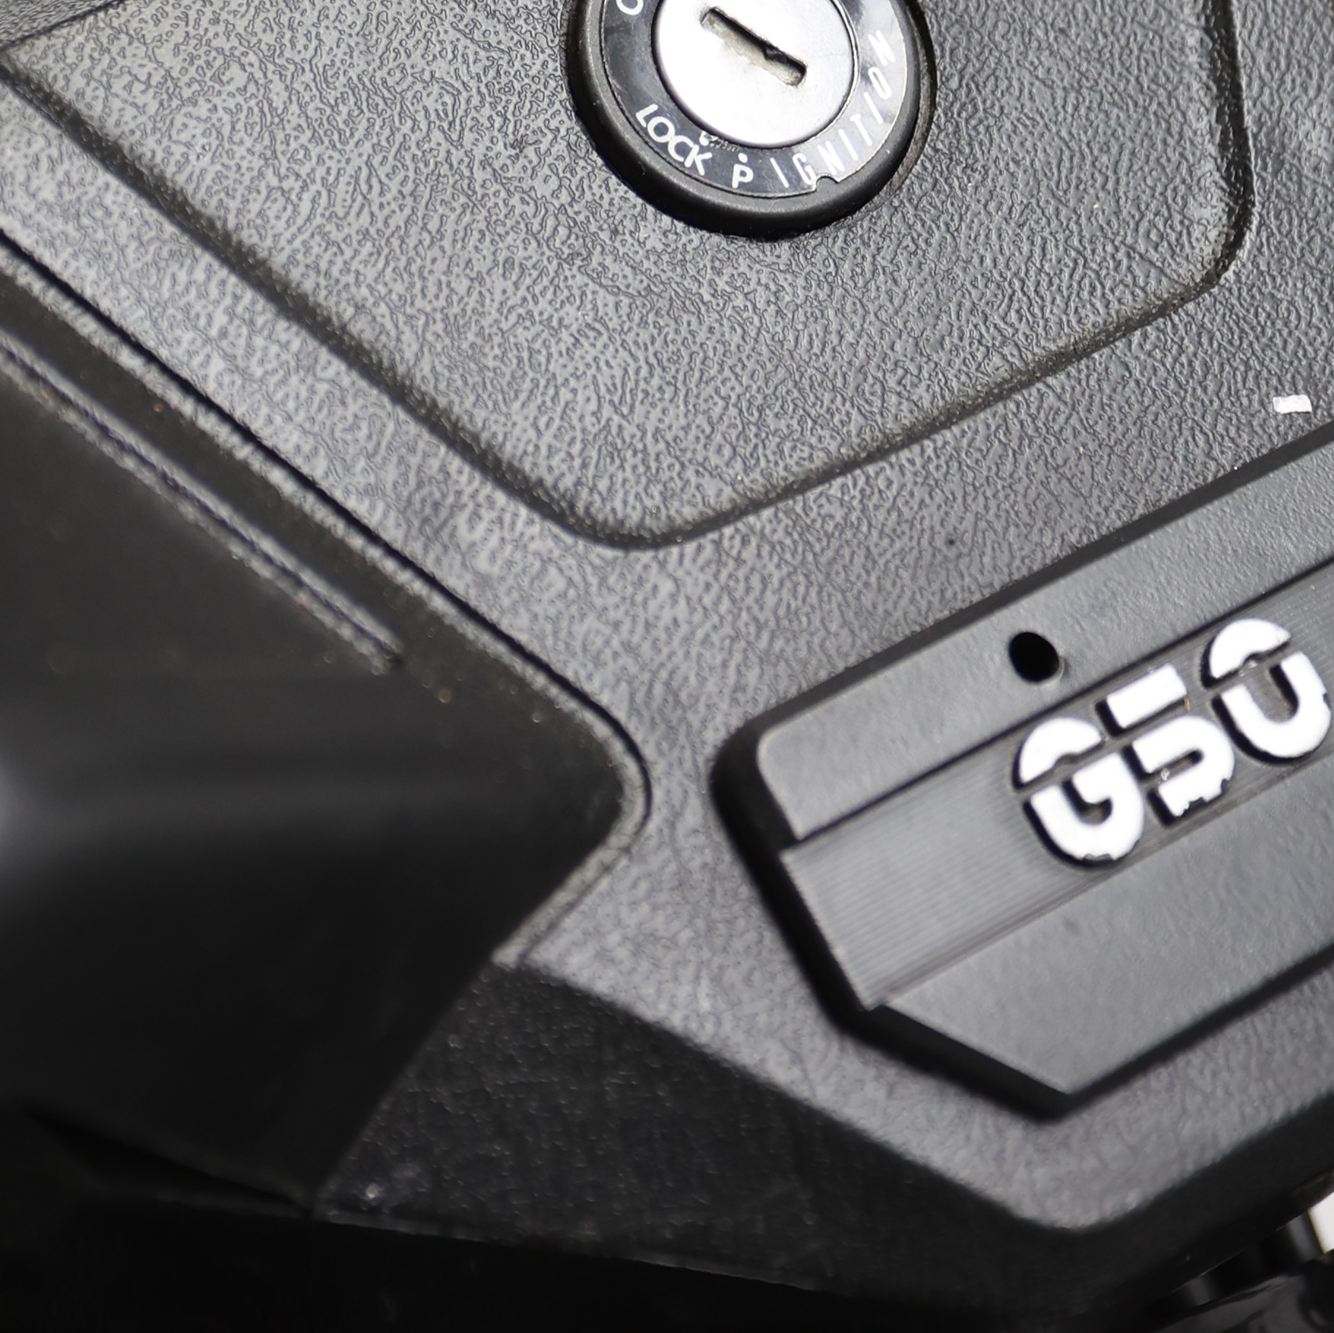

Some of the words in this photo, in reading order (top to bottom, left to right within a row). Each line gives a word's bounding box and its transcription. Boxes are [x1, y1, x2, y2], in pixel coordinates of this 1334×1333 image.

[635, 104, 713, 176] LOCK
[770, 30, 897, 188] IGNITION
[731, 163, 754, 189] P
